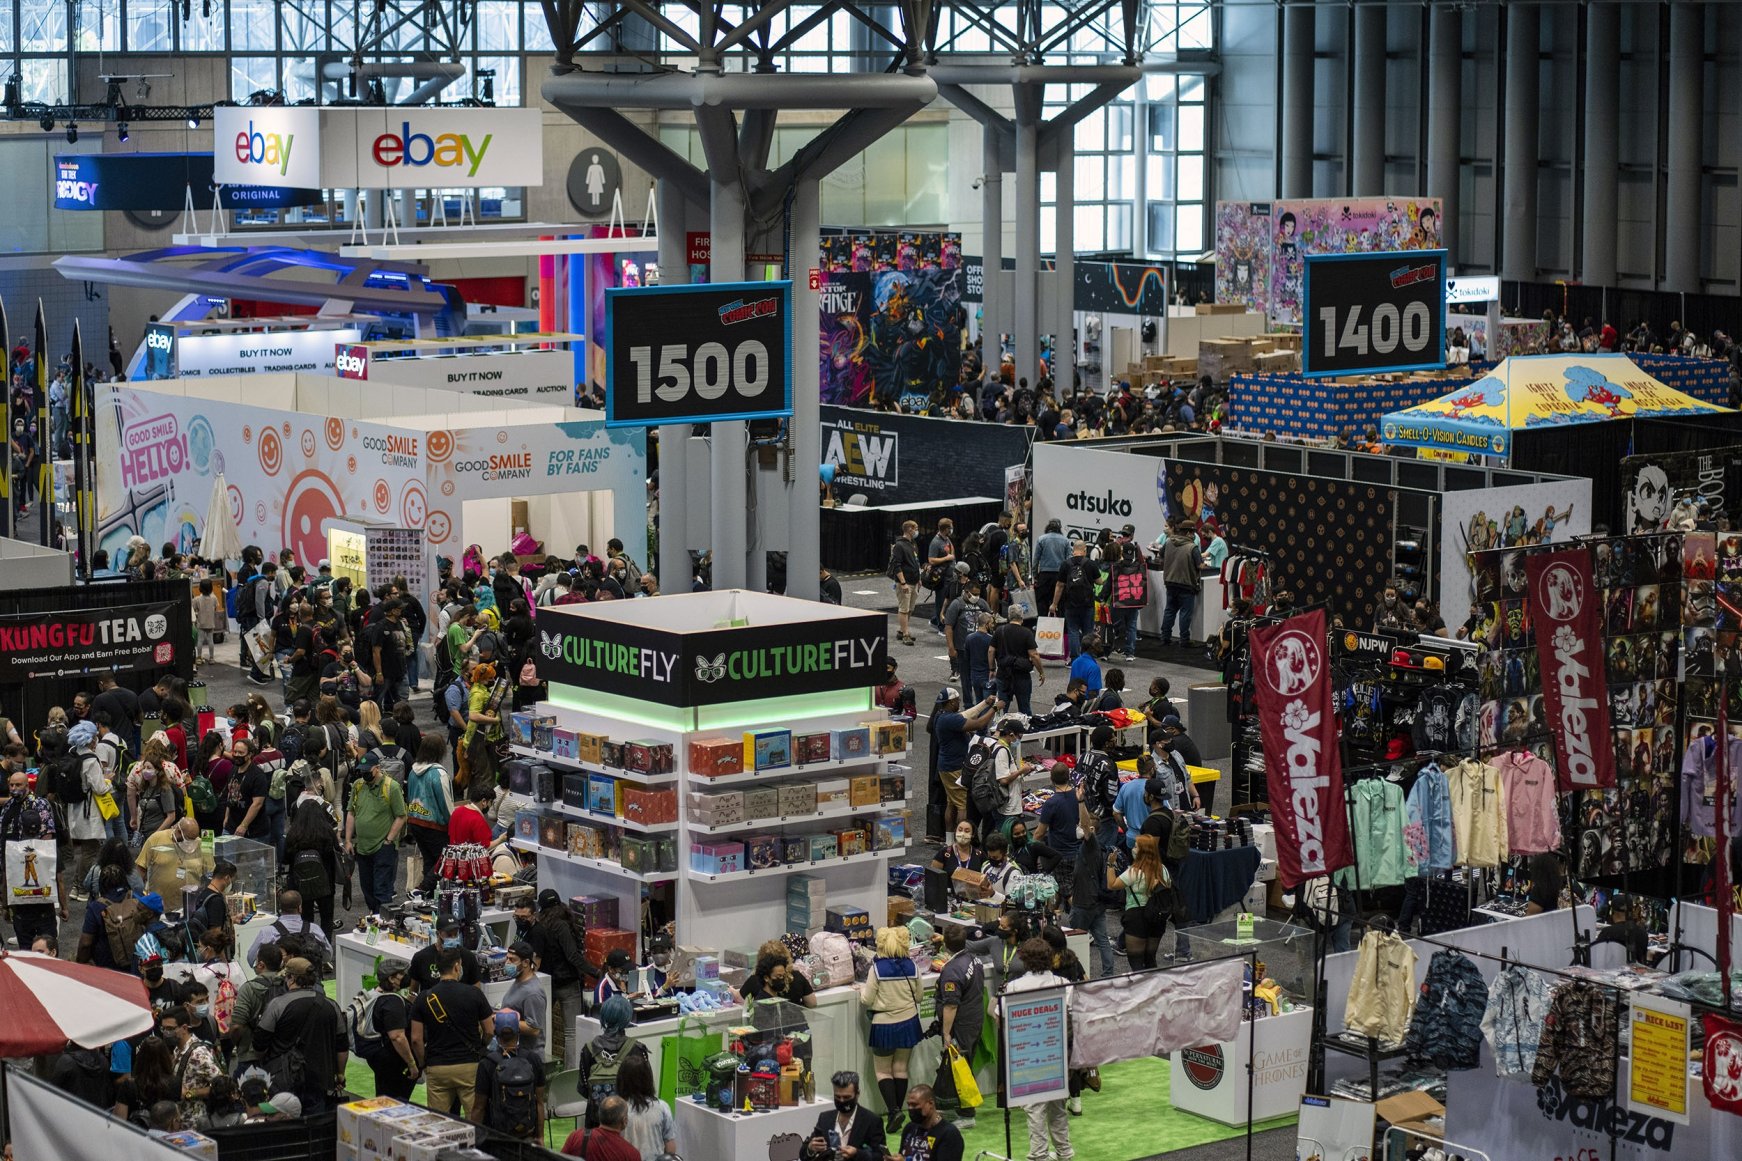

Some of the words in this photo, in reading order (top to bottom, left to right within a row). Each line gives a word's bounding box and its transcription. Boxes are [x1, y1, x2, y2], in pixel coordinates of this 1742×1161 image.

[235, 120, 294, 176] ebay
[372, 121, 493, 177] ebay
[232, 190, 280, 200] ORIGINAL
[695, 237, 710, 246] FIR
[691, 250, 711, 260] HOS
[966, 275, 983, 285] SHO
[966, 285, 983, 295] STO
[1459, 287, 1490, 297] tokidoki
[1319, 300, 1430, 358] 1400
[147, 330, 172, 354] ebay
[240, 350, 258, 358] BUY
[260, 349, 268, 358] IT
[270, 348, 292, 357] NOW
[208, 366, 256, 375] COLLECTIBLES
[264, 364, 293, 372] TRADING
[294, 363, 316, 372] CARDS
[336, 351, 366, 377] ebay
[629, 339, 769, 404] 1500
[447, 372, 466, 382] BUY
[468, 372, 478, 381] IT
[479, 370, 502, 380] NOW
[504, 387, 528, 395] CARDS
[536, 385, 567, 393] AUCTION
[1526, 382, 1558, 393] IGNITE
[902, 394, 930, 408] ebay
[1540, 392, 1560, 402] THE
[129, 431, 150, 446] GOOD
[152, 422, 174, 438] SMILE
[837, 420, 854, 430] ALL
[854, 424, 880, 434] ELITE
[120, 432, 190, 489] HELLO!
[382, 452, 418, 469] COMPANY
[549, 449, 576, 464] FOR
[578, 447, 610, 462] FANS
[824, 430, 894, 478] AEW
[547, 462, 562, 476] BY
[565, 461, 600, 474] FANS
[1698, 455, 1712, 472] THE
[482, 468, 532, 481] COMPANY
[834, 476, 885, 490] WRESTLING
[0, 623, 64, 652] KUNG
[66, 622, 96, 647] FU
[98, 617, 142, 645] TEA
[1360, 637, 1388, 654] NJPW
[12, 656, 48, 664] Download
[64, 654, 80, 662] App
[132, 646, 152, 654] Boba!
[563, 635, 677, 683] CULTUREFLY
[728, 636, 880, 681] CULTUREFLY
[1011, 1008, 1032, 1018] HUGE
[1034, 1004, 1059, 1015] DEALS
[1183, 1050, 1222, 1066] SUPERNATURAL
[1253, 1050, 1293, 1070] GAME
[1293, 1049, 1304, 1058] OF
[1254, 1063, 1305, 1087] HRONES
